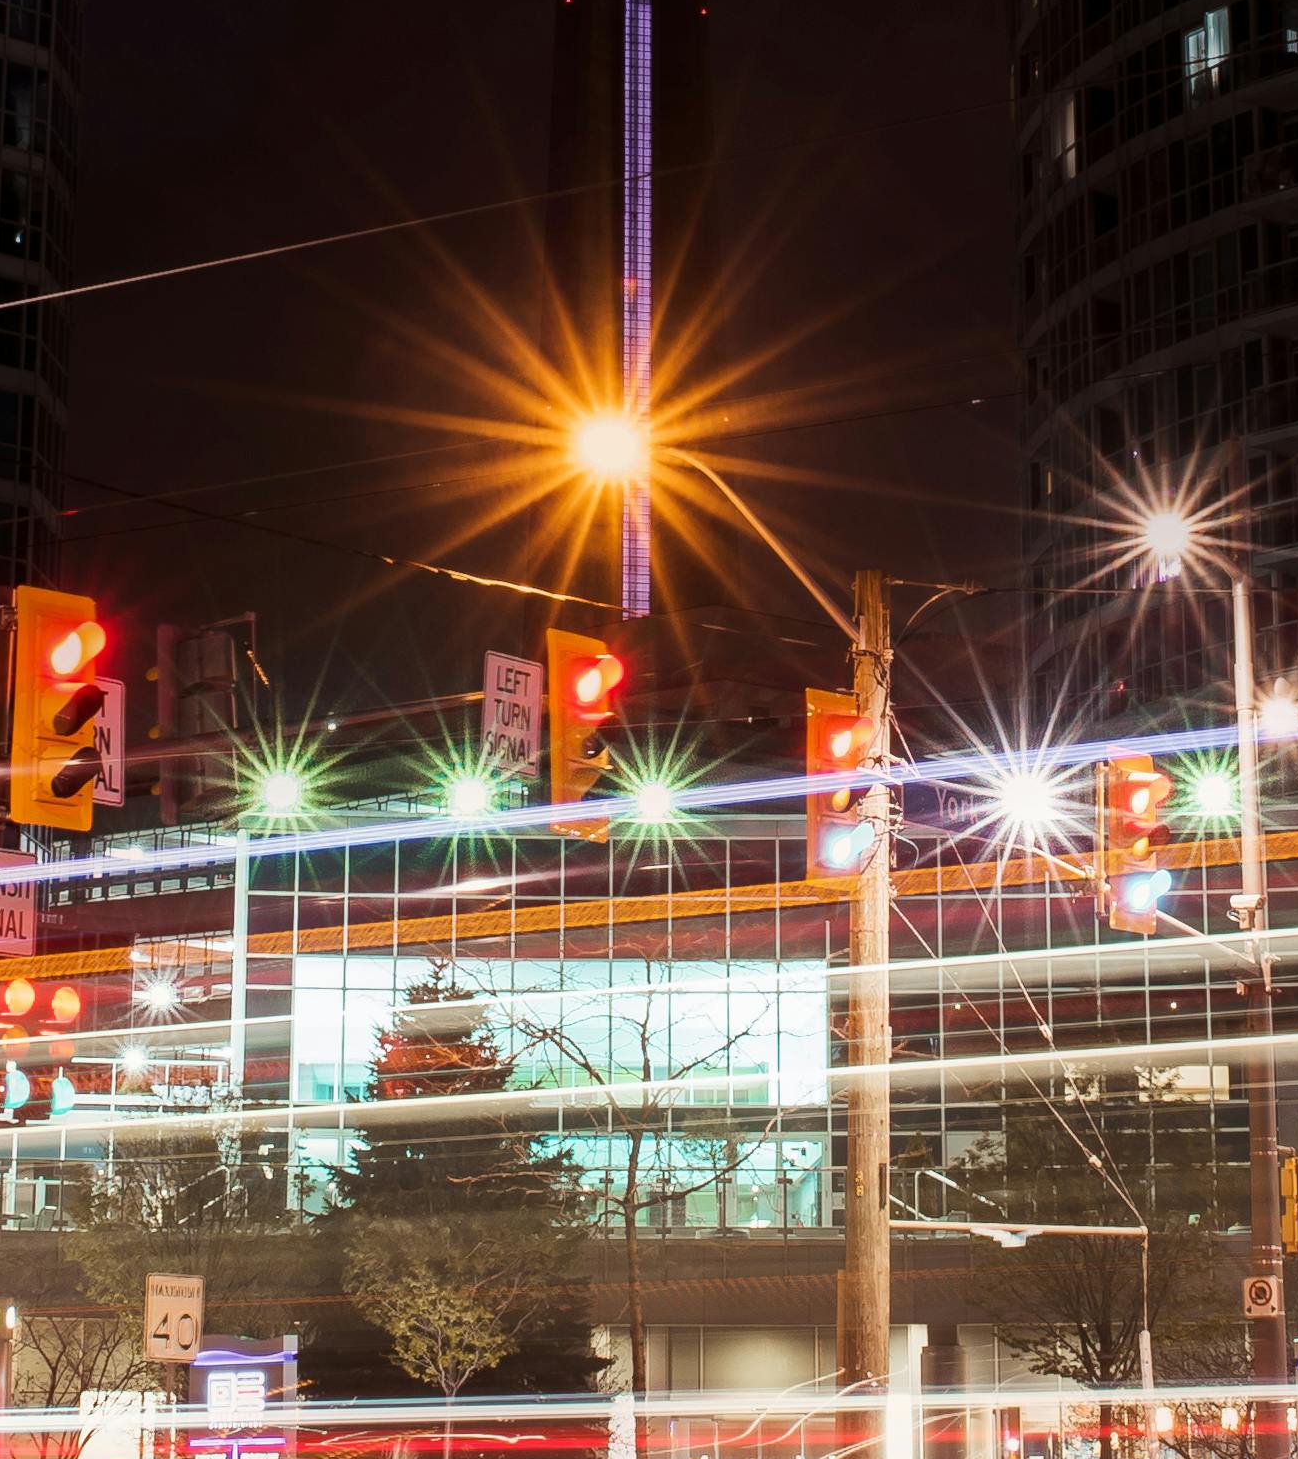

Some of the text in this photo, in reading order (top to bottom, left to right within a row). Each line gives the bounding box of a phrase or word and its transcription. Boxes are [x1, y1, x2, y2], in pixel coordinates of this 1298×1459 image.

[497, 665, 531, 697] LEFT
[494, 698, 532, 732] TURN
[486, 730, 536, 766] SIGNAL
[151, 1313, 199, 1350] 40
